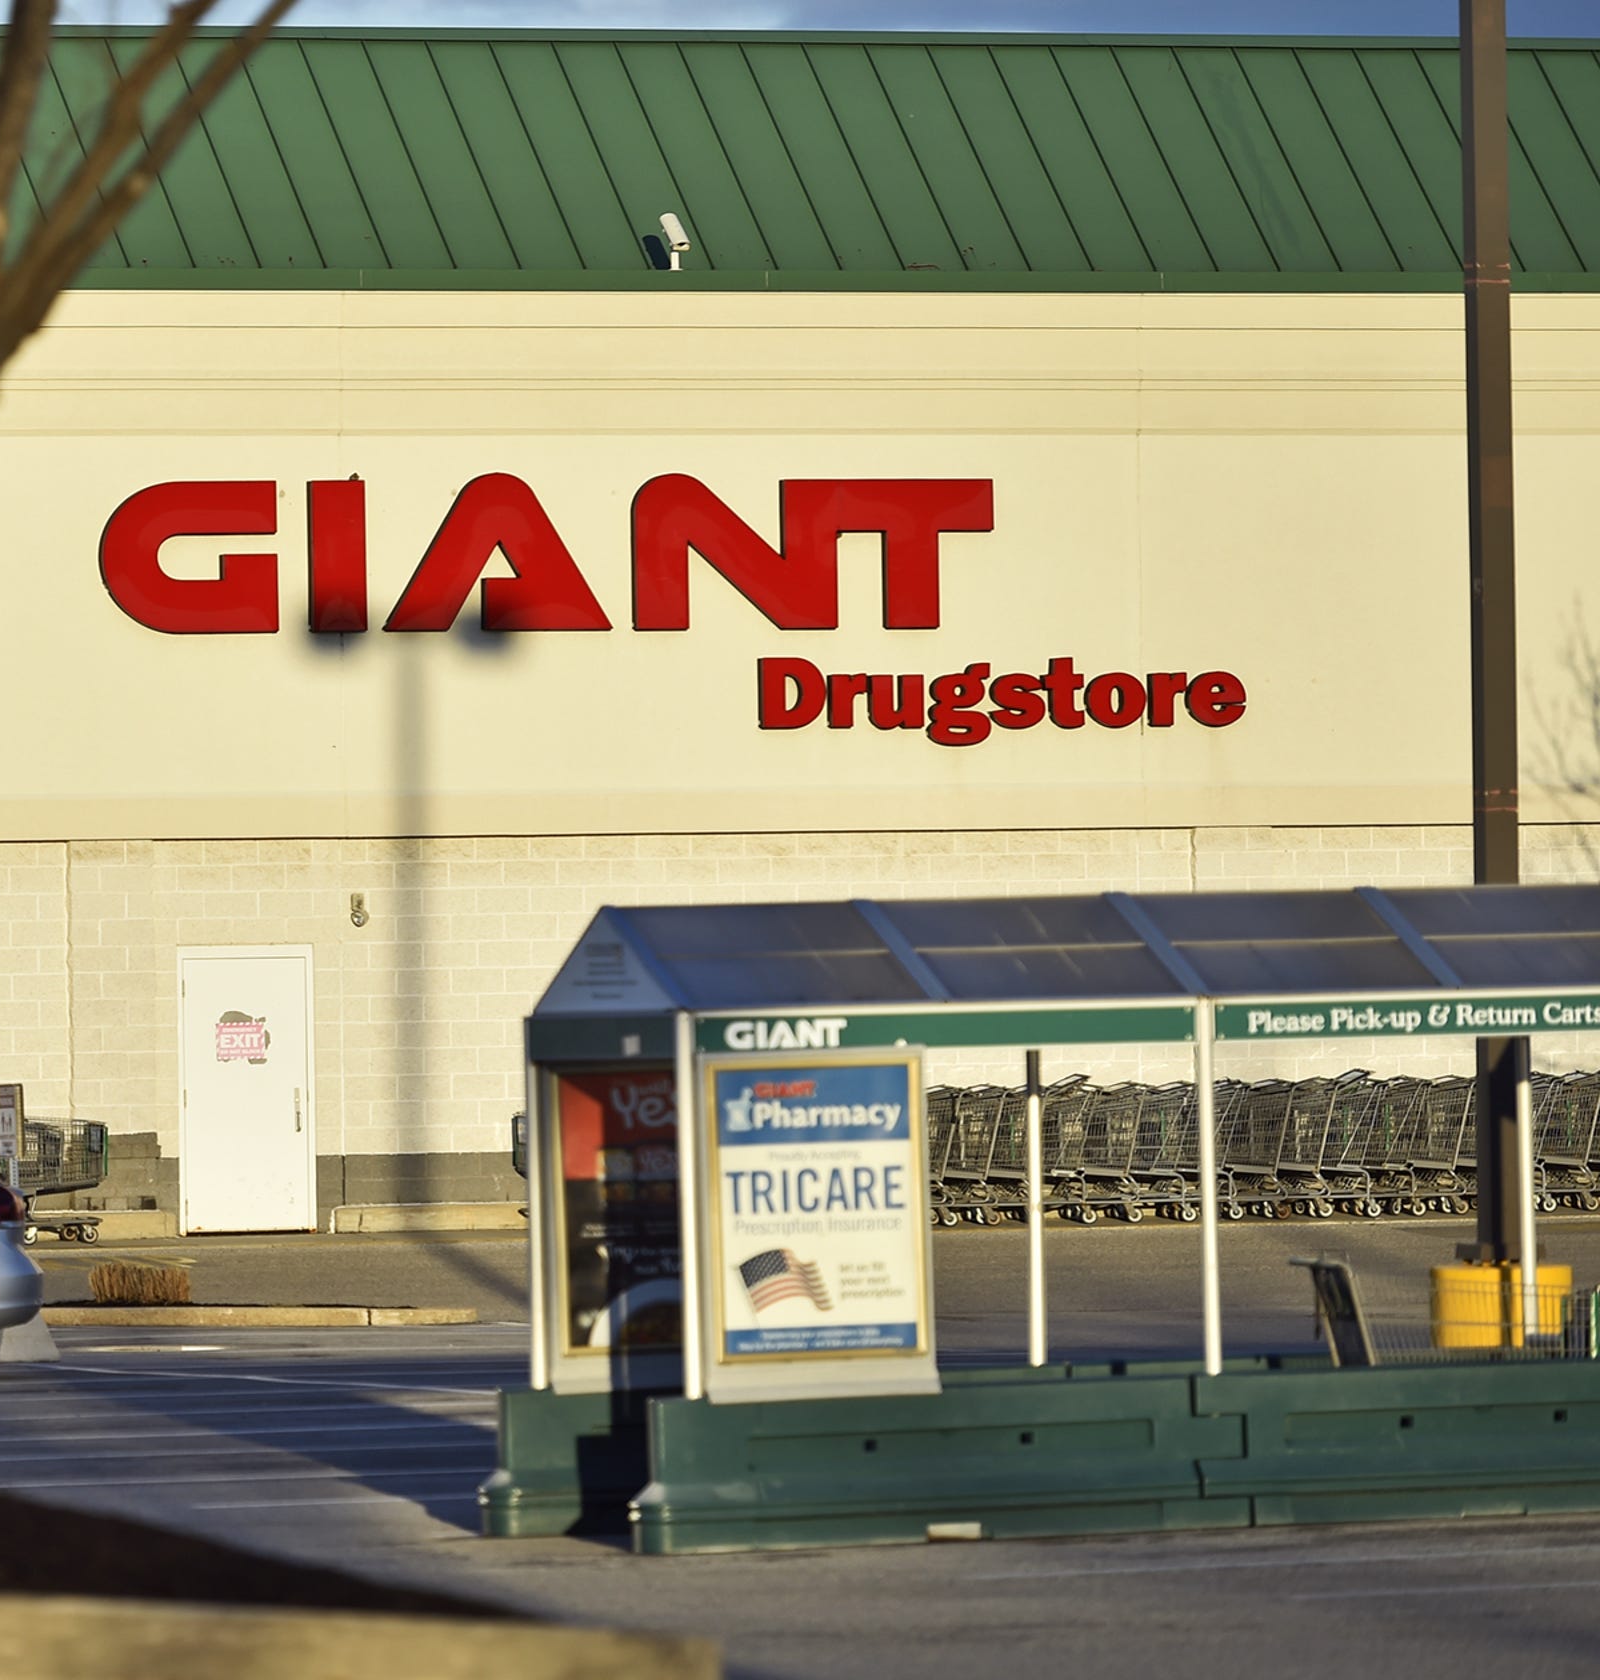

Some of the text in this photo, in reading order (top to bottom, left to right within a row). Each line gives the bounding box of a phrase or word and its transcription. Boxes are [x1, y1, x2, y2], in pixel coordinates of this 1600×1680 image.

[98, 472, 994, 634] GIANT
[757, 657, 1246, 747] Drugstore
[723, 1018, 847, 1049] GIANT
[1247, 1001, 1600, 1034] Please Pick-up & Return Carts
[219, 1033, 261, 1048] EXIT
[752, 1100, 901, 1133] Pharmacy
[725, 1165, 904, 1214] TRICARE
[734, 1217, 902, 1237] Prescription Insurance
